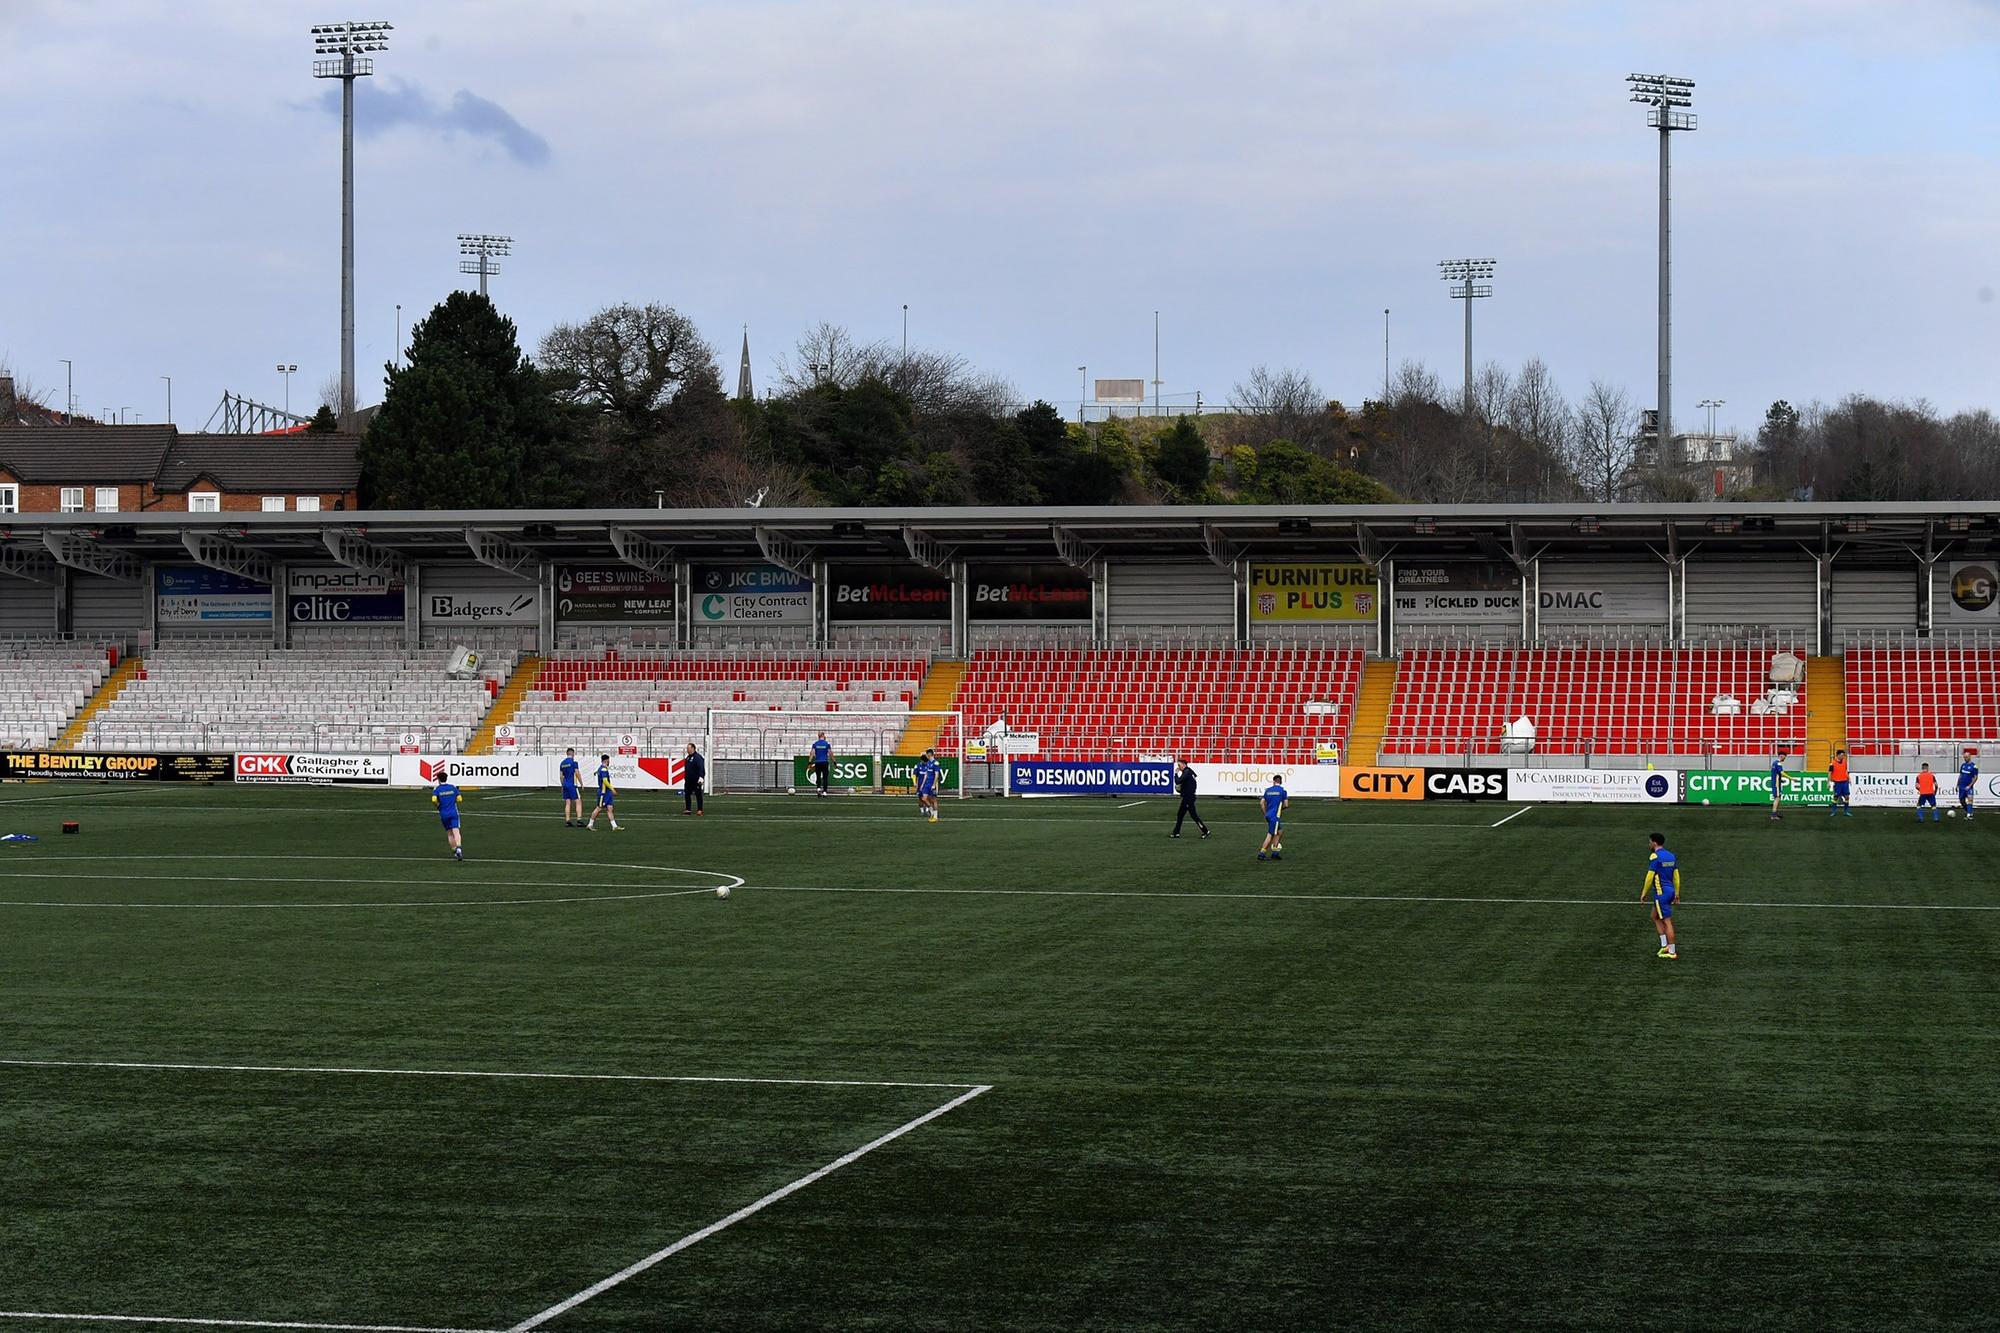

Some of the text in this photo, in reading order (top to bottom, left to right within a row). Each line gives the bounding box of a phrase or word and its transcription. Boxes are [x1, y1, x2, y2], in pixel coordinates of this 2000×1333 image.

[576, 571, 614, 583] GEE'S
[728, 572, 801, 587] JKC BMW
[1252, 568, 1378, 586] FURNITURE
[837, 584, 947, 602] BetMcLean
[976, 584, 1089, 602] BetMcLean
[1287, 591, 1342, 609] PLUS
[1540, 591, 1603, 608] DMAC
[432, 596, 503, 620] Badgers
[624, 600, 672, 608] NEW LEAF
[734, 596, 808, 608] City Contract
[1395, 598, 1416, 608] THE
[1484, 598, 1519, 608] DUCK
[734, 608, 783, 619] Cleaners
[7, 755, 36, 768] THE
[39, 754, 104, 769] BENTLEY
[106, 757, 157, 770] GROUP
[240, 757, 283, 772] GMK
[297, 756, 371, 768] Gallagher &
[449, 762, 520, 777] Diamond
[53, 770, 82, 778] Supports
[83, 769, 106, 778] Derry
[107, 769, 124, 778] City
[297, 766, 385, 776] McKinney Ltd
[1017, 768, 1170, 786] DM DESMOND MOTORS
[1353, 773, 1503, 794] CITY CABS
[1603, 773, 1641, 785] DUFFY
[1689, 776, 1732, 791] CITY
[1855, 775, 1909, 785] Filtered
[1592, 791, 1641, 799] PRACTITIONERS
[1855, 787, 1914, 796] Aesthetics
